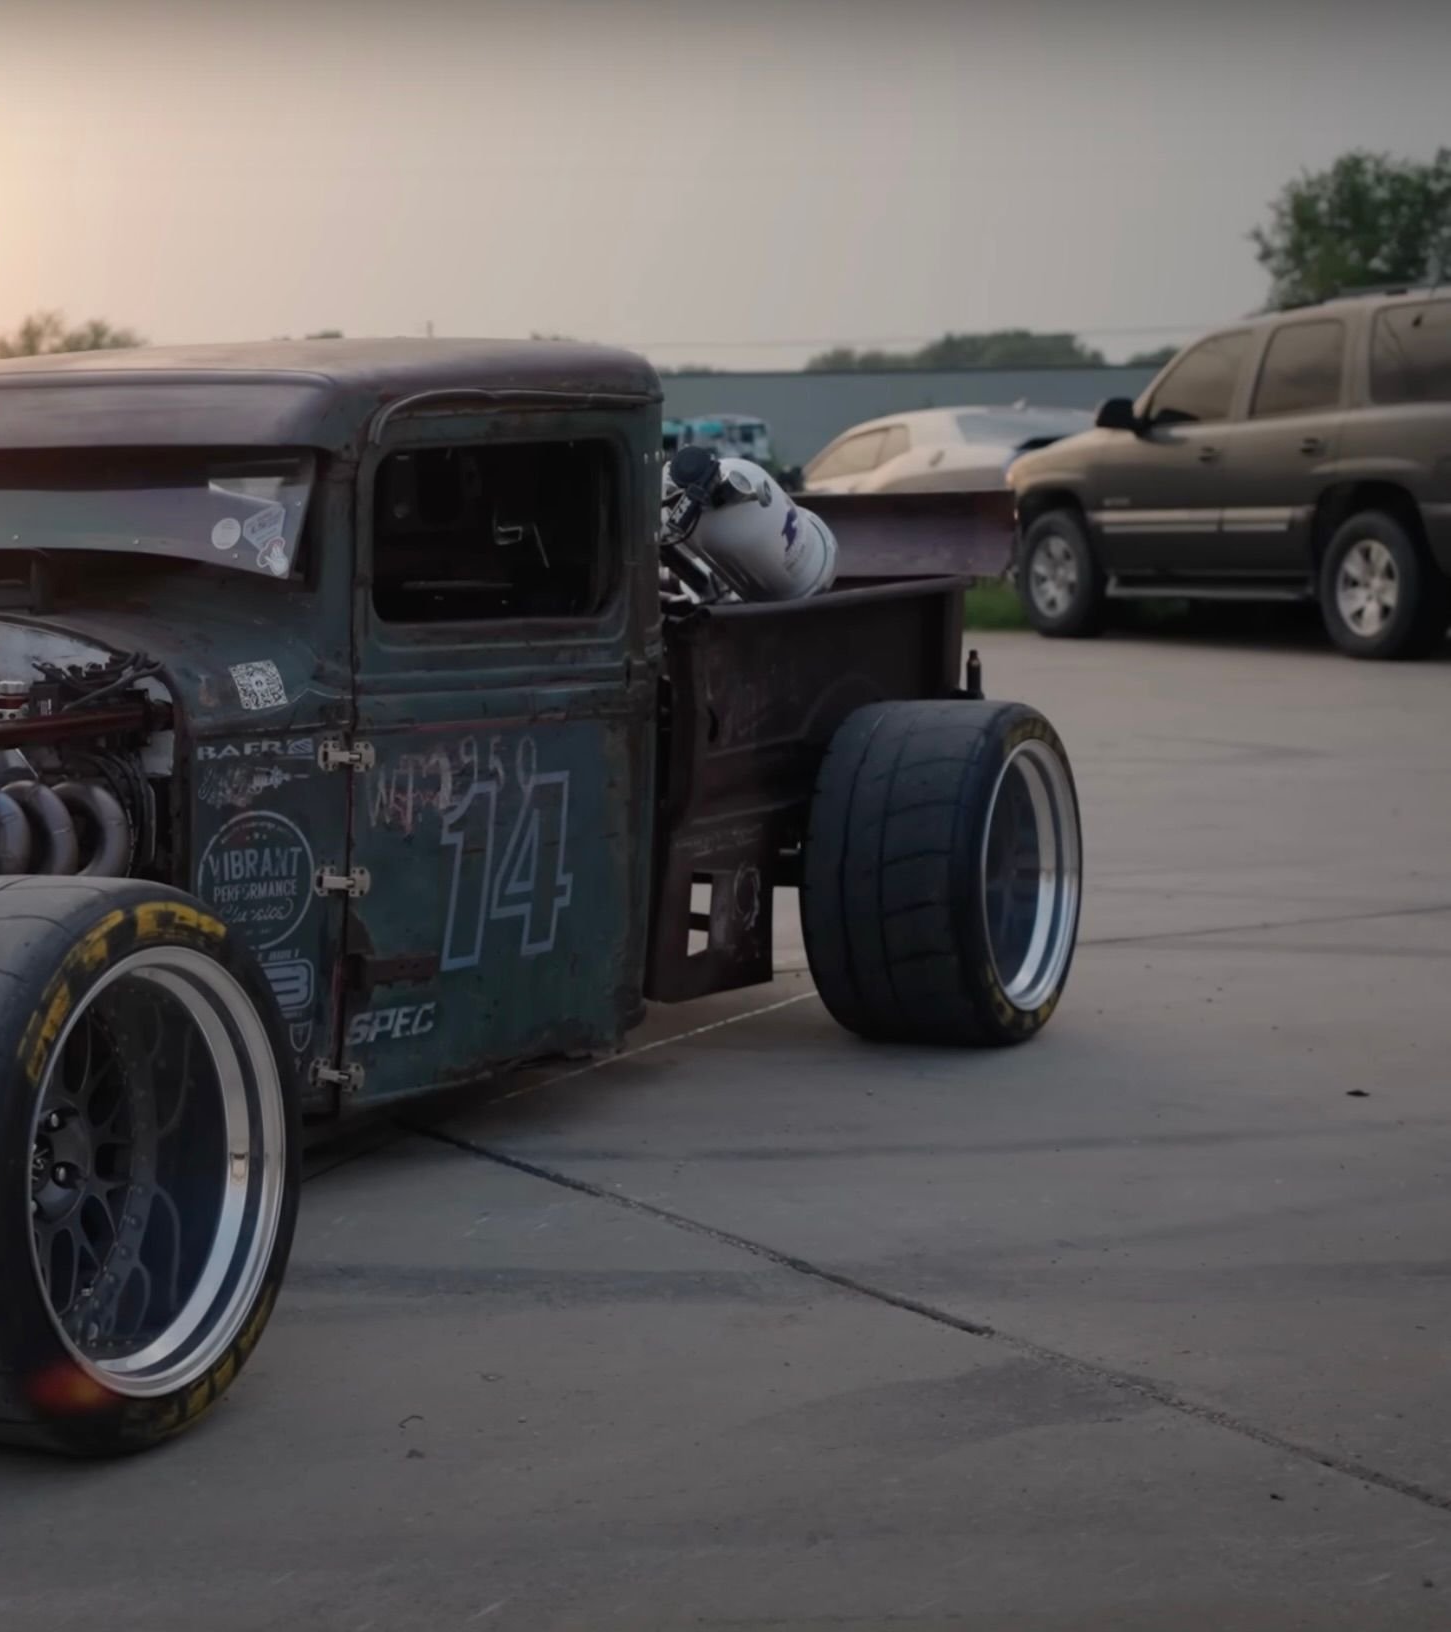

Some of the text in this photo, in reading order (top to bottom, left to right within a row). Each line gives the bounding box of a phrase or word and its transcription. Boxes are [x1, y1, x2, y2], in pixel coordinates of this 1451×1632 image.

[208, 846, 302, 883] VIBRANT
[440, 769, 573, 973] 14
[345, 1001, 437, 1046] SPEC
